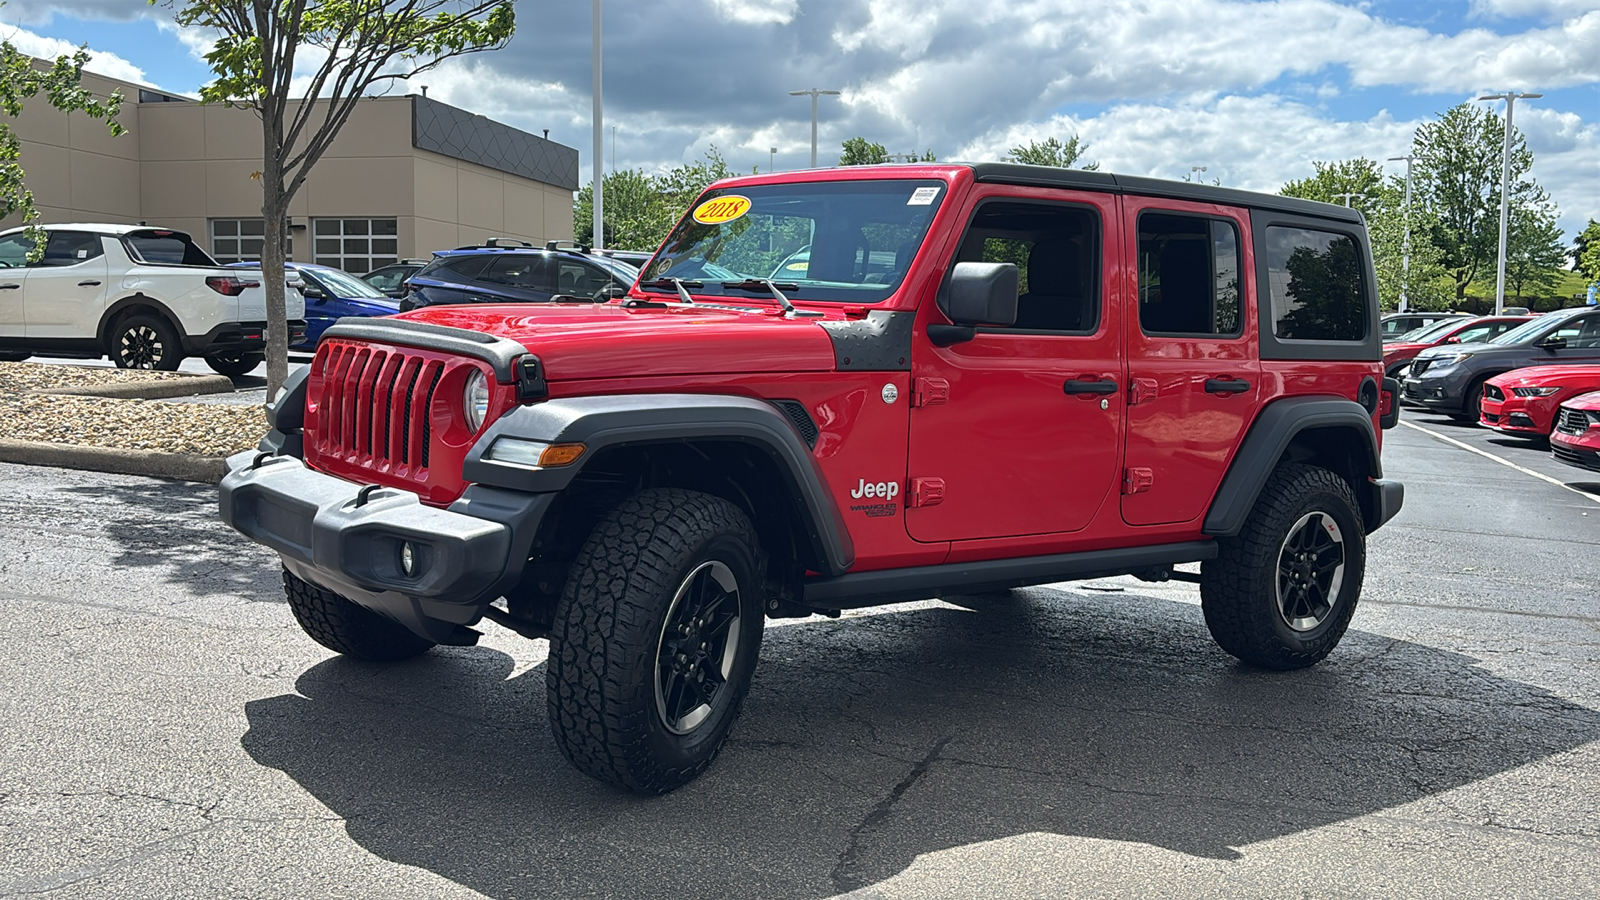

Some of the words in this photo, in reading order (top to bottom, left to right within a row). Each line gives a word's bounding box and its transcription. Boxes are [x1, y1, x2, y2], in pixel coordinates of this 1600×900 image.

[699, 200, 745, 218] 2018
[851, 478, 899, 501] Jeep
[850, 503, 897, 512] WRANGLER
